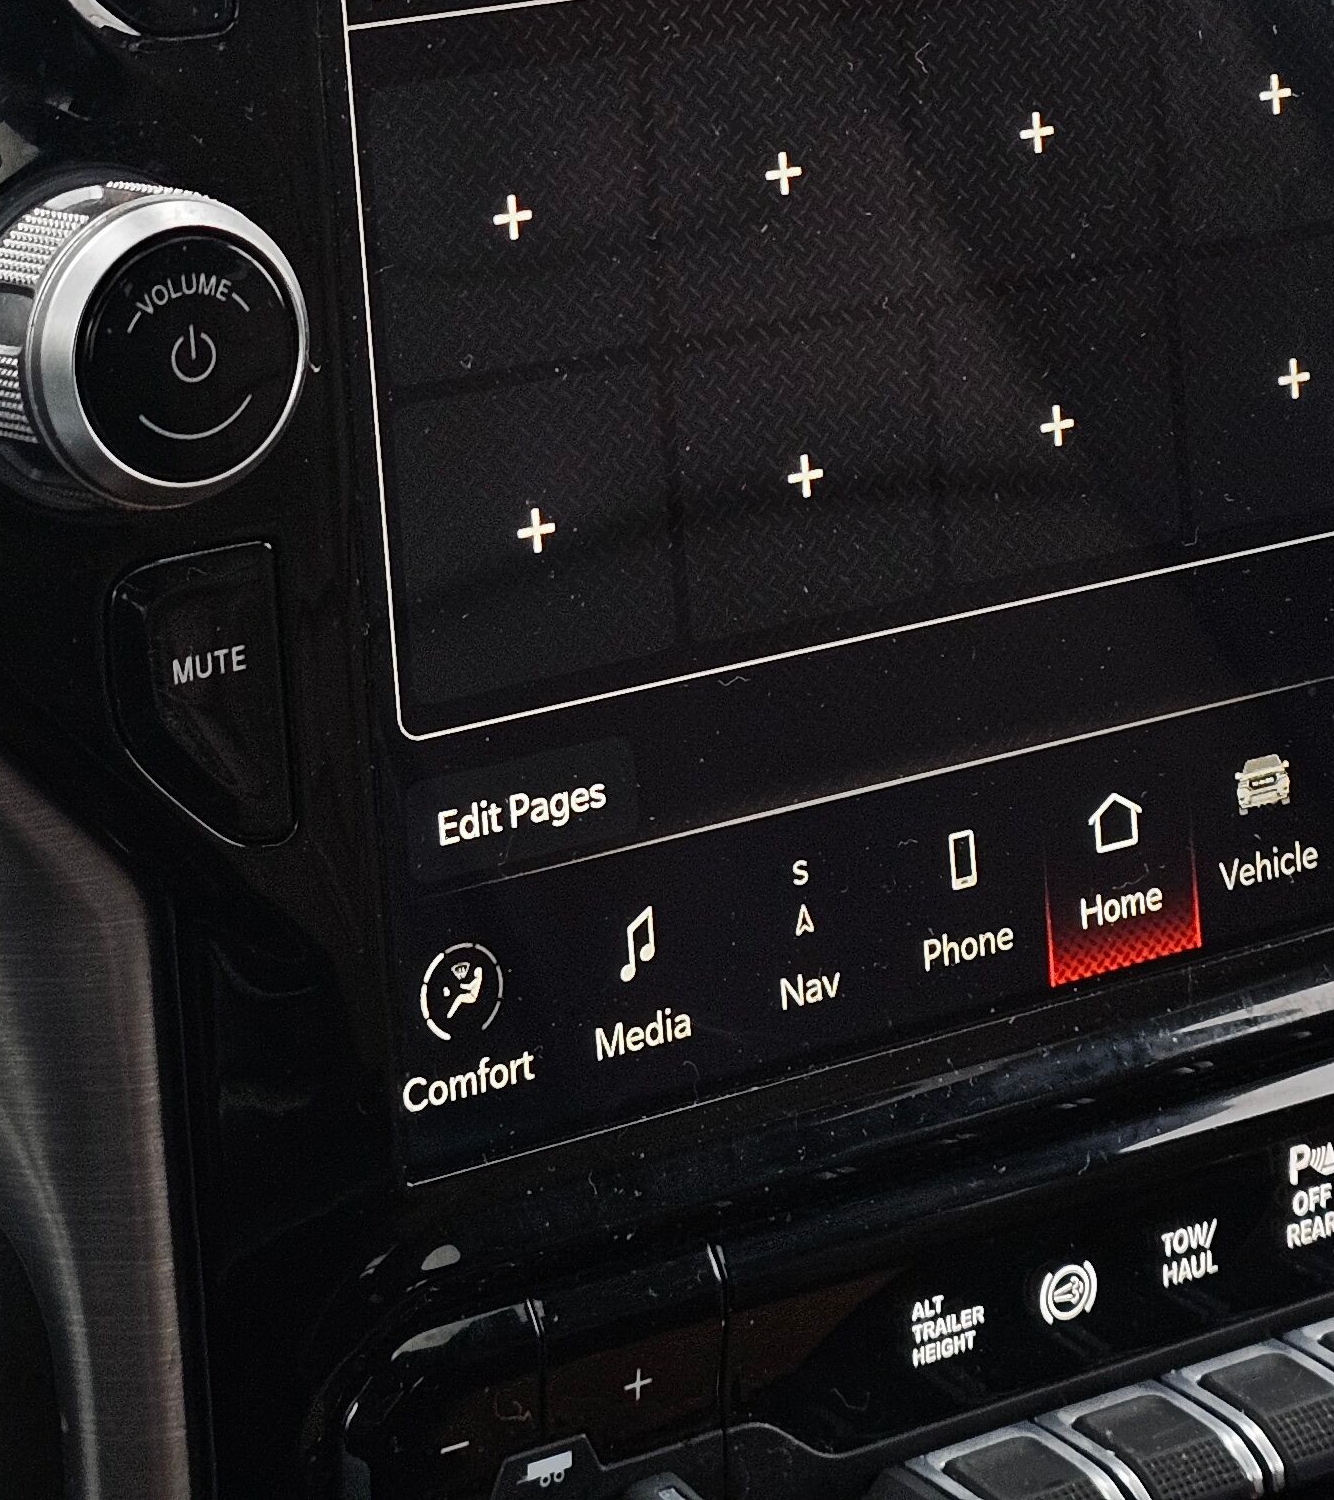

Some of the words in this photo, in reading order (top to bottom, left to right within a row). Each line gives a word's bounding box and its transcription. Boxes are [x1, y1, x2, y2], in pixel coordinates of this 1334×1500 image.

[135, 272, 232, 315] VOLUME
[172, 644, 247, 685] MUTE
[437, 799, 504, 847] Edit
[508, 783, 607, 829] Pages
[792, 859, 809, 886] S
[1218, 840, 1319, 891] Vehicle
[1080, 887, 1163, 930] Home
[923, 927, 1014, 973] Phone
[779, 971, 841, 1011] Nav
[594, 1007, 692, 1062] Media
[402, 1050, 536, 1113] Comfort
[1291, 1182, 1333, 1217] OFF
[1160, 1217, 1218, 1258] TOW/
[1162, 1249, 1219, 1289] HAUL
[911, 1294, 945, 1322] ALT
[911, 1305, 985, 1345] TRAILER
[911, 1329, 977, 1369] HEIGHT
